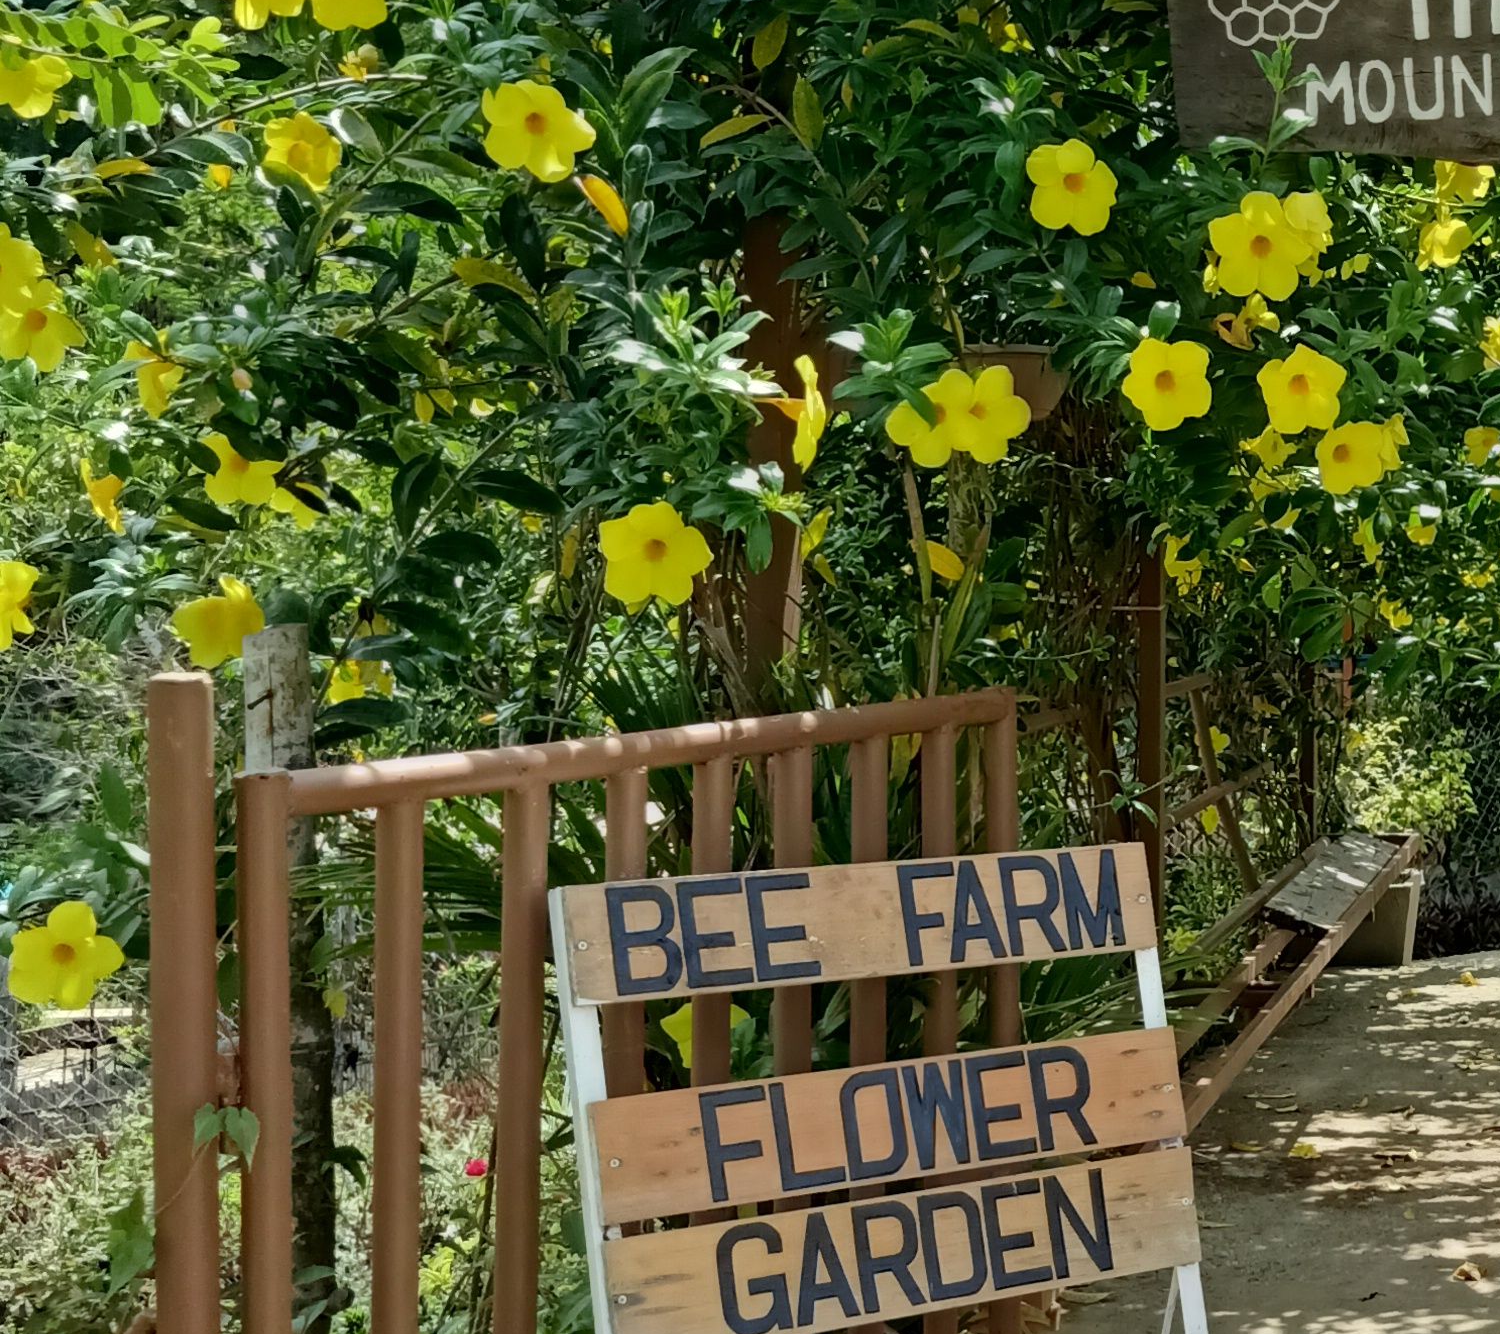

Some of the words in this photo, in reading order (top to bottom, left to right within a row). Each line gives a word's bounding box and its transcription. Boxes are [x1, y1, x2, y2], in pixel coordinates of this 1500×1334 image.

[605, 873, 822, 997] BEE
[896, 849, 1125, 967] FARM
[699, 1045, 1098, 1203] FLOWER
